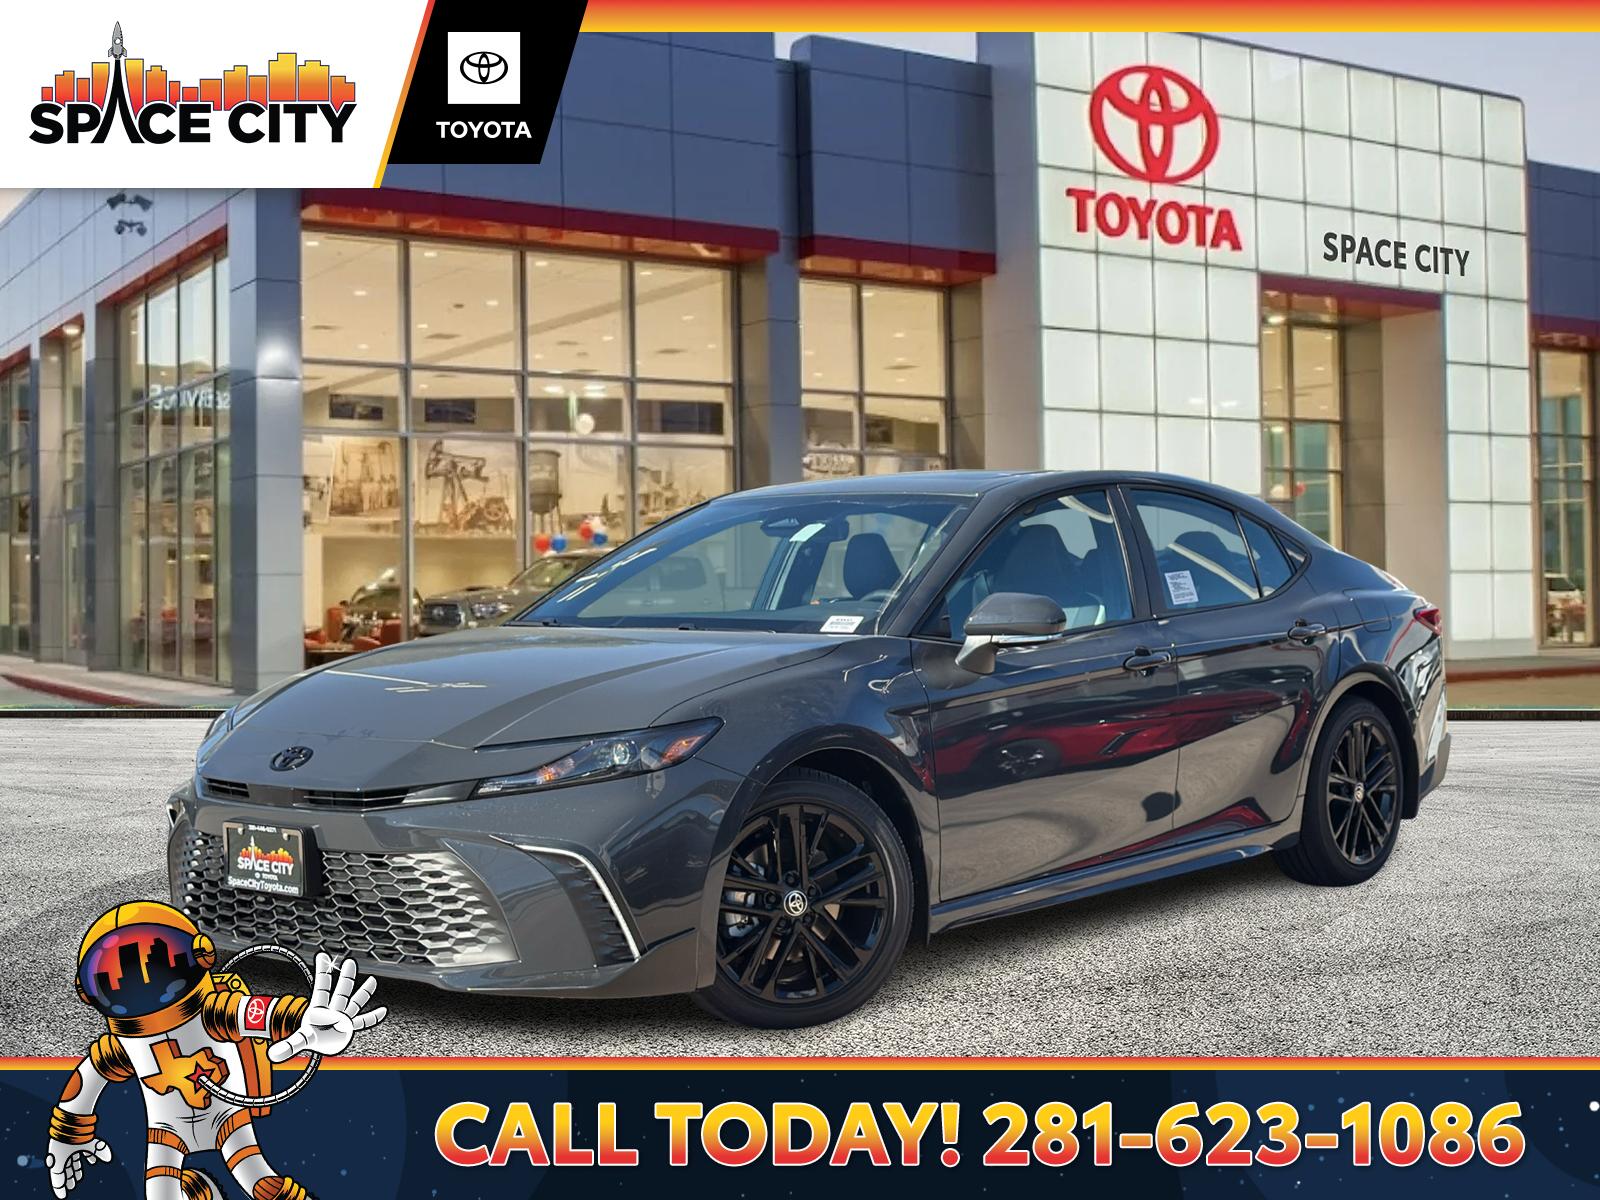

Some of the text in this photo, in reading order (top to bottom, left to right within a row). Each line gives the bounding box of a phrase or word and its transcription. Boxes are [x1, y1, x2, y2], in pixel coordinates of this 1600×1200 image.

[1065, 187, 1243, 251] TOYOTA
[1323, 231, 1470, 277] SPACE CITY
[237, 853, 294, 876] SPACE CITY
[227, 875, 299, 895] SpaceCityToyota.com
